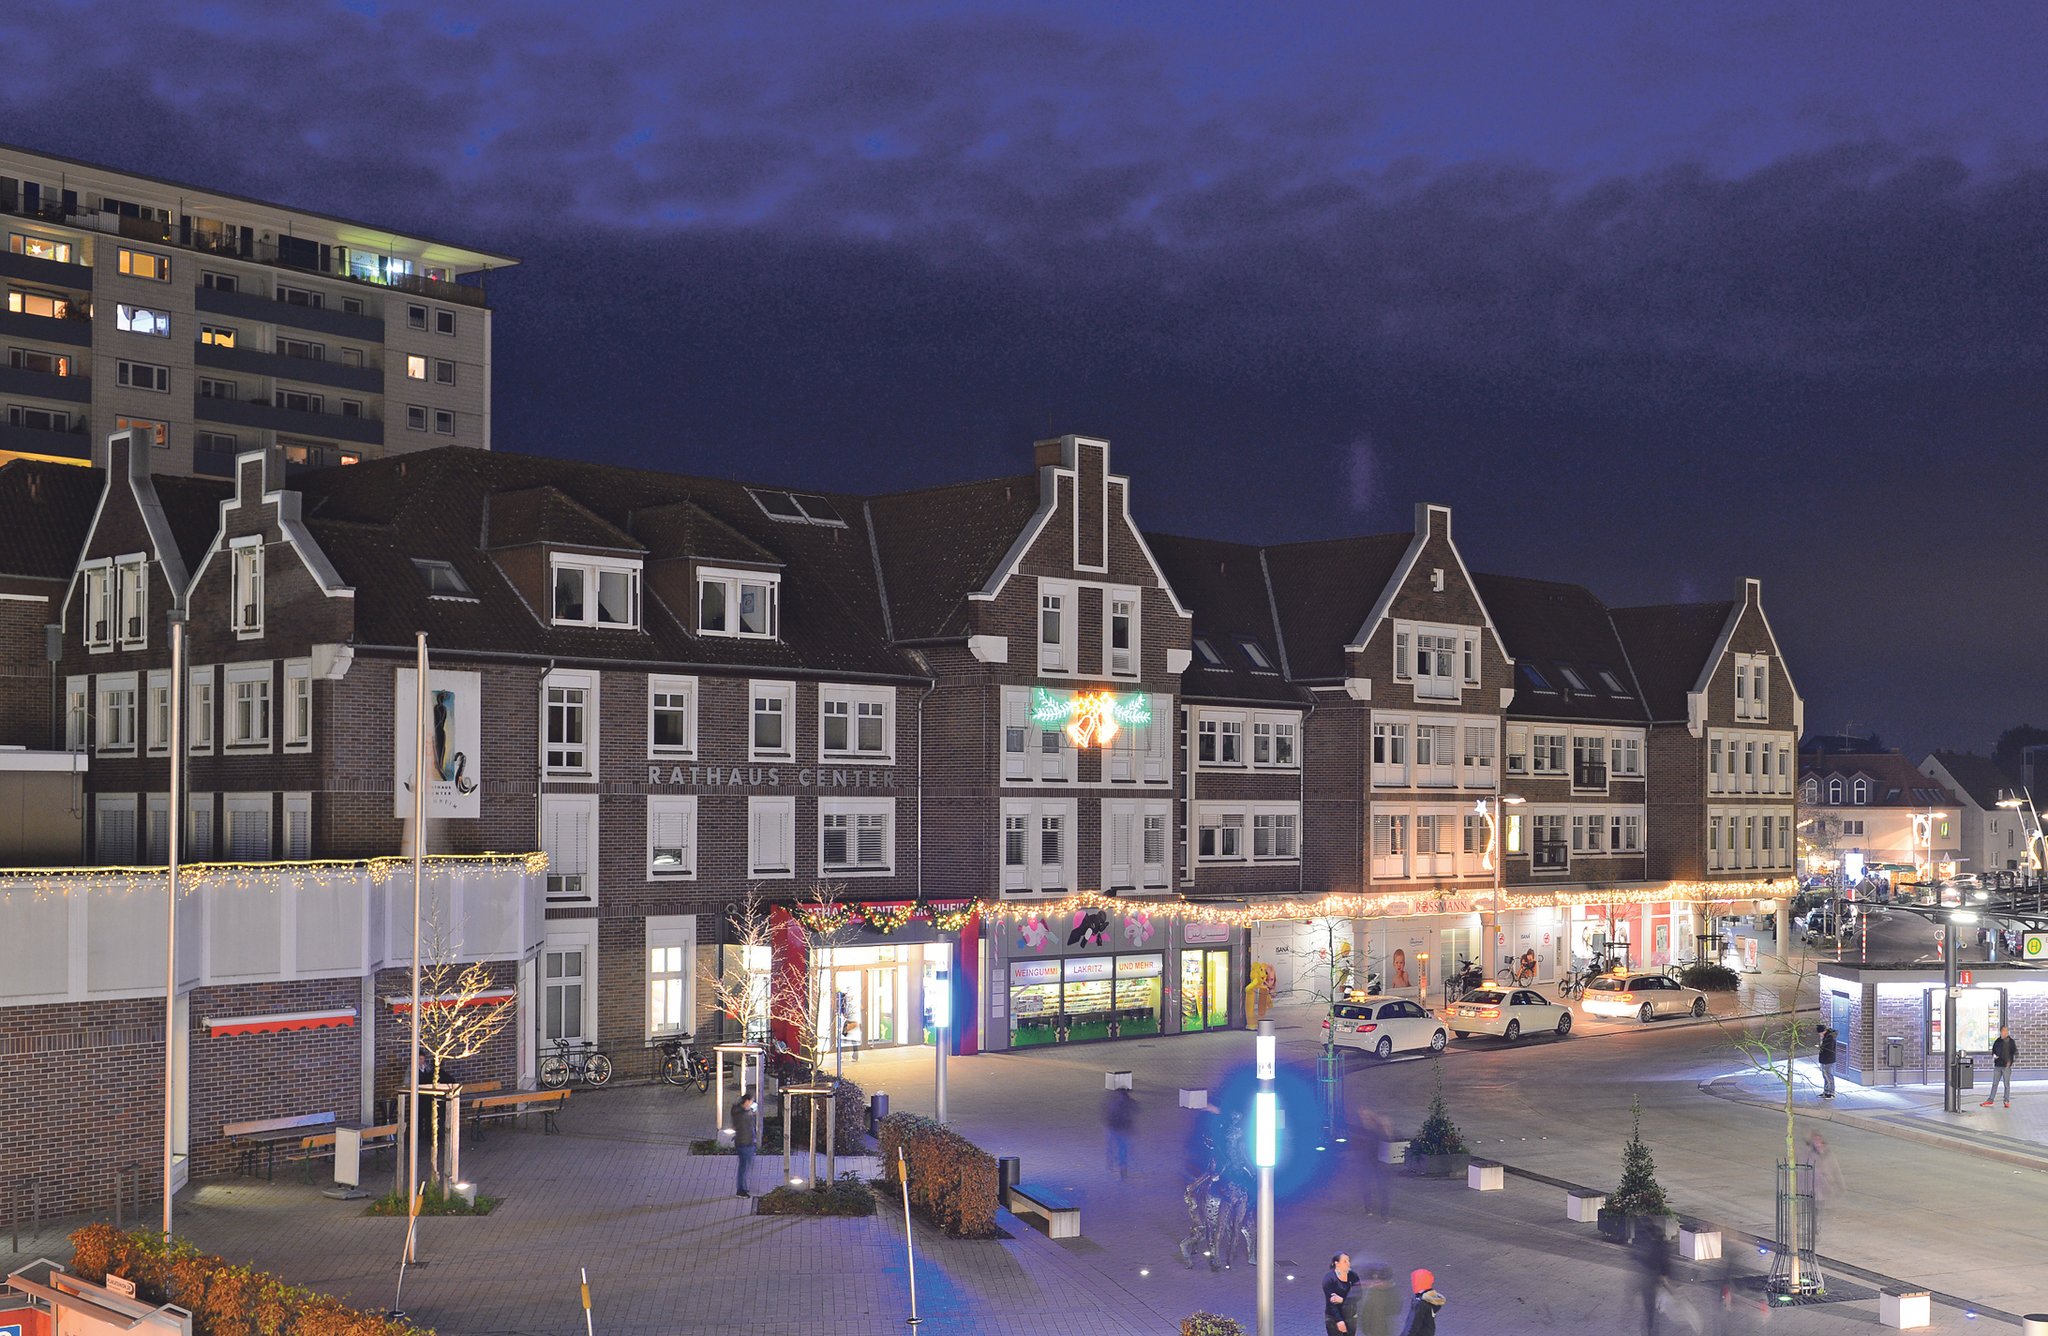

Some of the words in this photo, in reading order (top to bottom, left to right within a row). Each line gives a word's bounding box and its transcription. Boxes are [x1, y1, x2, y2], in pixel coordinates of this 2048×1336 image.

[648, 766, 780, 786] RATHAUS
[798, 768, 896, 787] CENTER
[1415, 900, 1468, 913] ROSSMANN
[1073, 964, 1103, 974] LAKRITZ
[1119, 962, 1133, 971] UND
[1015, 967, 1058, 977] WEINGUMMI
